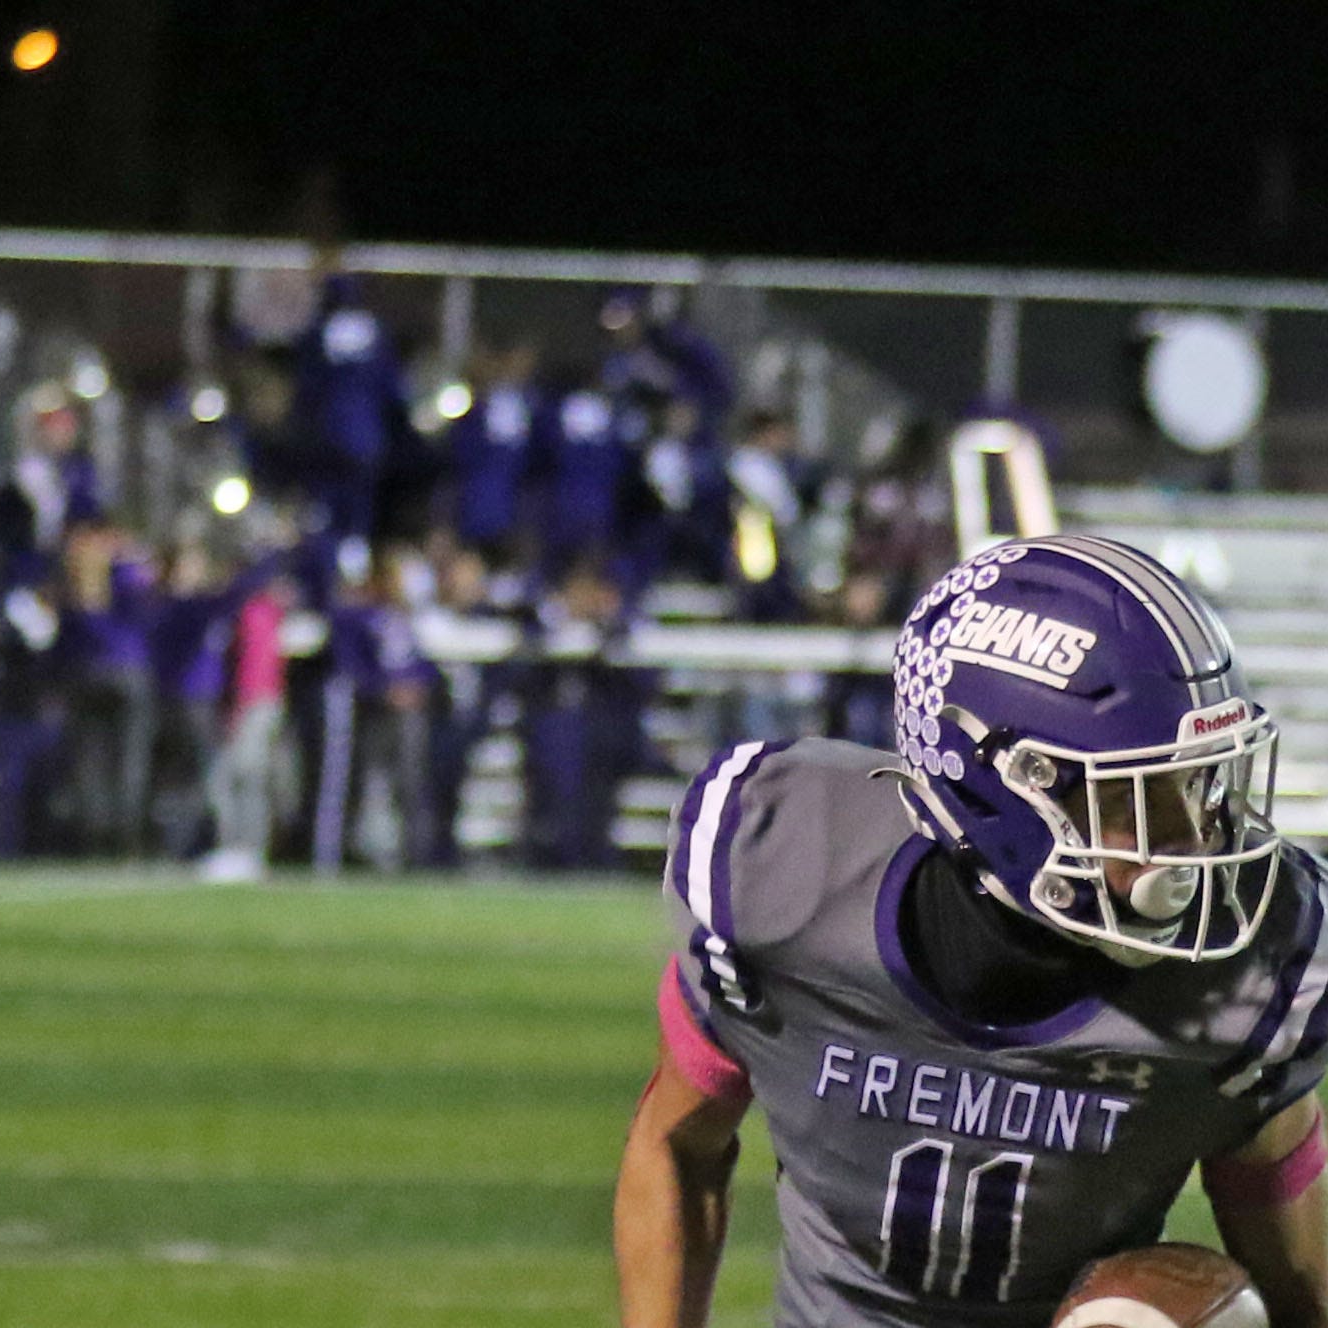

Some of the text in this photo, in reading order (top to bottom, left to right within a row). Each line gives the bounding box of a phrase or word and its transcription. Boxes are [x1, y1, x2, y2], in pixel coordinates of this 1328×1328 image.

[949, 601, 1097, 676] GIANTS
[1193, 703, 1246, 735] Riddell
[815, 1044, 1129, 1153] FREMONT
[879, 1138, 1034, 1301] 11
